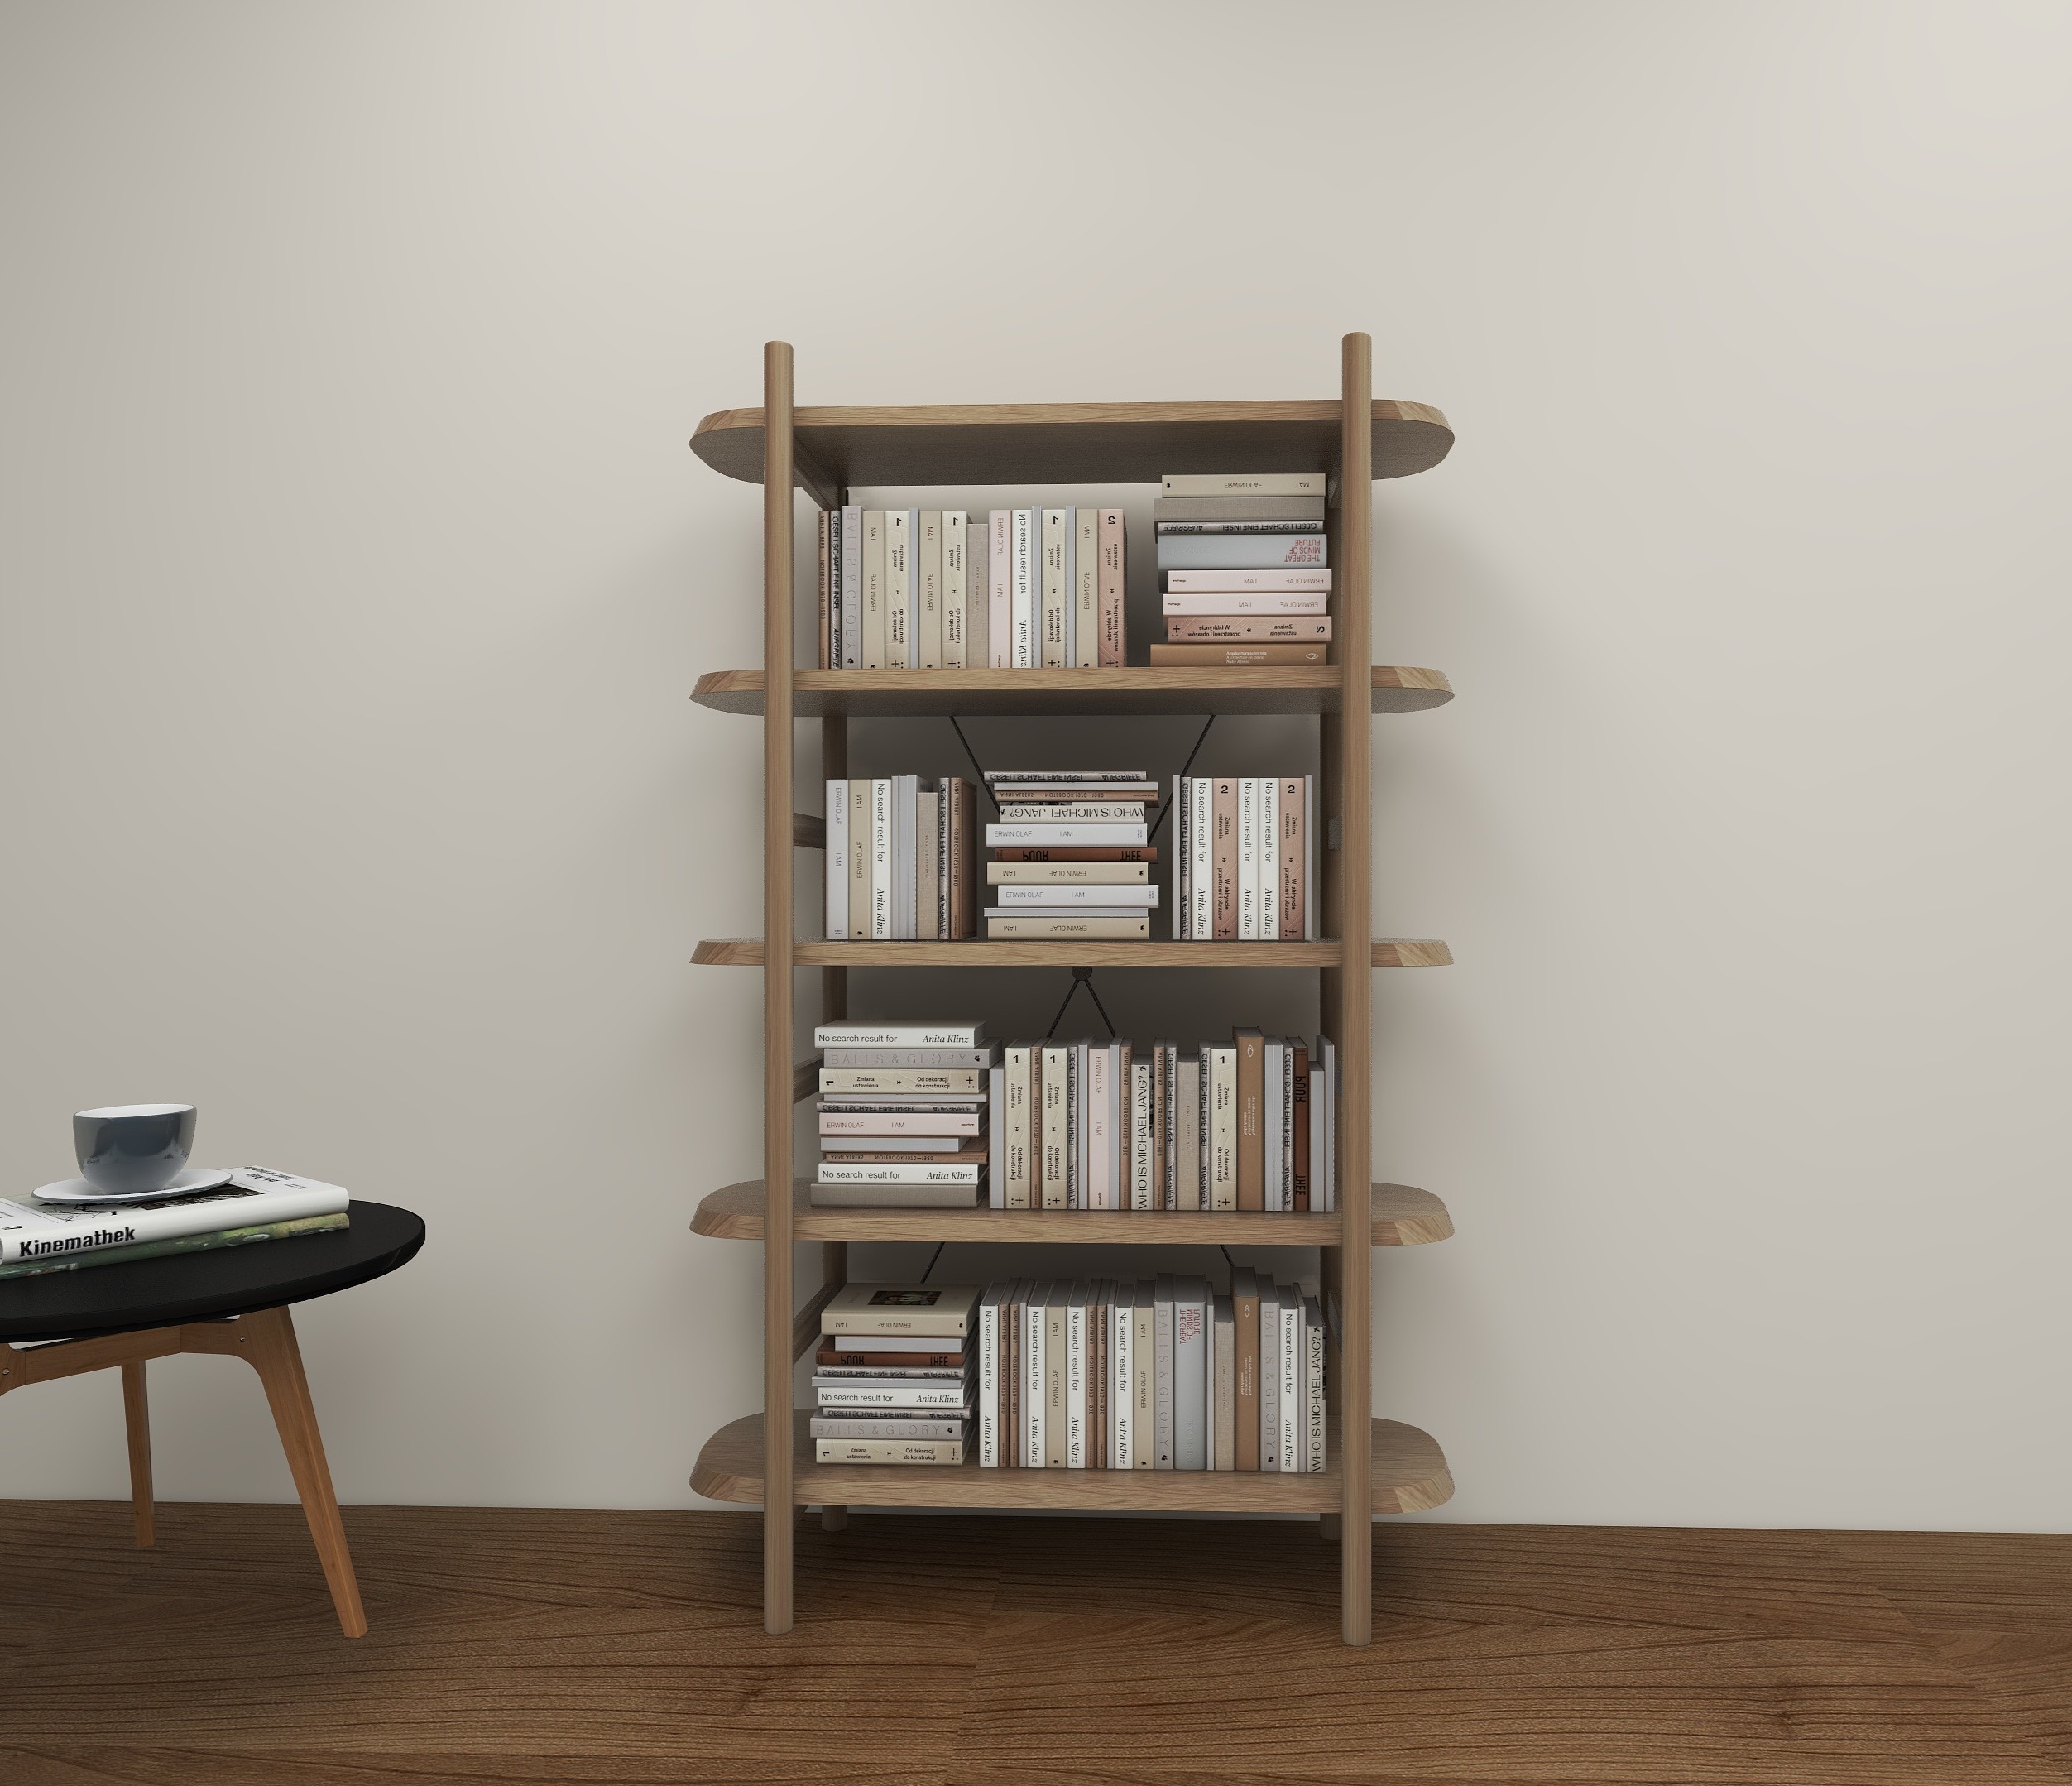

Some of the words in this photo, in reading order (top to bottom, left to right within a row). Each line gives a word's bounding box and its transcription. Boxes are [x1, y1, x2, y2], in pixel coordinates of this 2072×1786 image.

[1284, 554, 1306, 562] GREAT
[876, 783, 885, 795] No
[1197, 782, 1206, 794] No
[1244, 782, 1252, 794] No
[1264, 782, 1273, 794] No
[1288, 785, 1295, 794] 2
[876, 798, 885, 823] search
[1010, 808, 1046, 817] JANG?
[1048, 808, 1098, 817] MICHAEL
[1101, 808, 1111, 817] IS
[1114, 808, 1144, 817] WHO
[1197, 796, 1206, 823] search
[1264, 796, 1273, 823] search
[876, 827, 885, 848] result
[1197, 826, 1206, 847] result
[1264, 826, 1273, 847] result
[836, 856, 842, 866] AM
[876, 852, 885, 862] for
[1197, 851, 1206, 862] for
[1244, 851, 1252, 862] for
[1264, 851, 1273, 862] for
[876, 888, 885, 910] Anita
[1197, 888, 1206, 910] Anita
[1244, 888, 1252, 910] Anita
[1264, 888, 1273, 910] Anita
[876, 913, 885, 934] Klinz
[1197, 913, 1206, 935] Klinz
[1244, 913, 1252, 935] Klinz
[1264, 913, 1273, 935] Klinz
[819, 1035, 830, 1043] No
[832, 1035, 859, 1043] search
[861, 1035, 884, 1043] result
[886, 1035, 897, 1043] for
[923, 1035, 945, 1043] Anita
[947, 1035, 969, 1043] Klinz
[831, 1054, 885, 1065] BALLS
[892, 1054, 899, 1065] &
[907, 1054, 967, 1065] GLORY
[1138, 1076, 1147, 1111] JANG?
[1096, 1125, 1102, 1135] AM
[1138, 1113, 1147, 1164] MICHAEL
[823, 1171, 834, 1179] No
[836, 1171, 863, 1179] search
[866, 1171, 887, 1179] result
[890, 1171, 901, 1179] for
[927, 1171, 948, 1179] Anita
[952, 1171, 972, 1179] Klinz
[1138, 1167, 1147, 1177] IS
[1137, 1179, 1148, 1211] WHO
[19, 1225, 136, 1258] Kinemathek
[984, 1310, 991, 1322] No
[1031, 1311, 1039, 1323] No
[1071, 1312, 1079, 1323] No
[1119, 1312, 1126, 1323] No
[1284, 1314, 1293, 1325] No
[1031, 1325, 1039, 1352] search
[1071, 1326, 1079, 1352] search
[1284, 1328, 1293, 1355] search
[1031, 1355, 1039, 1376] result
[1312, 1337, 1321, 1373] JANG?
[1071, 1355, 1079, 1377] result
[1284, 1357, 1293, 1380] result
[1031, 1380, 1039, 1390] for
[1071, 1380, 1079, 1391] for
[1284, 1383, 1293, 1394] for
[821, 1394, 832, 1403] No
[834, 1394, 858, 1403] search
[861, 1394, 880, 1403] result
[883, 1394, 893, 1403] for
[916, 1394, 937, 1403] Anita
[938, 1394, 959, 1403] Klinz
[1312, 1374, 1321, 1426] MICHAEL
[1031, 1416, 1039, 1439] Anita
[1071, 1417, 1079, 1439] Anita
[1284, 1419, 1293, 1443] Anita
[1312, 1428, 1321, 1438] IS
[1031, 1441, 1039, 1463] Klinz
[1071, 1442, 1079, 1463] Klinz
[1119, 1443, 1127, 1464] Klinz
[1284, 1444, 1293, 1467] Klinz
[1311, 1442, 1321, 1472] WHO
